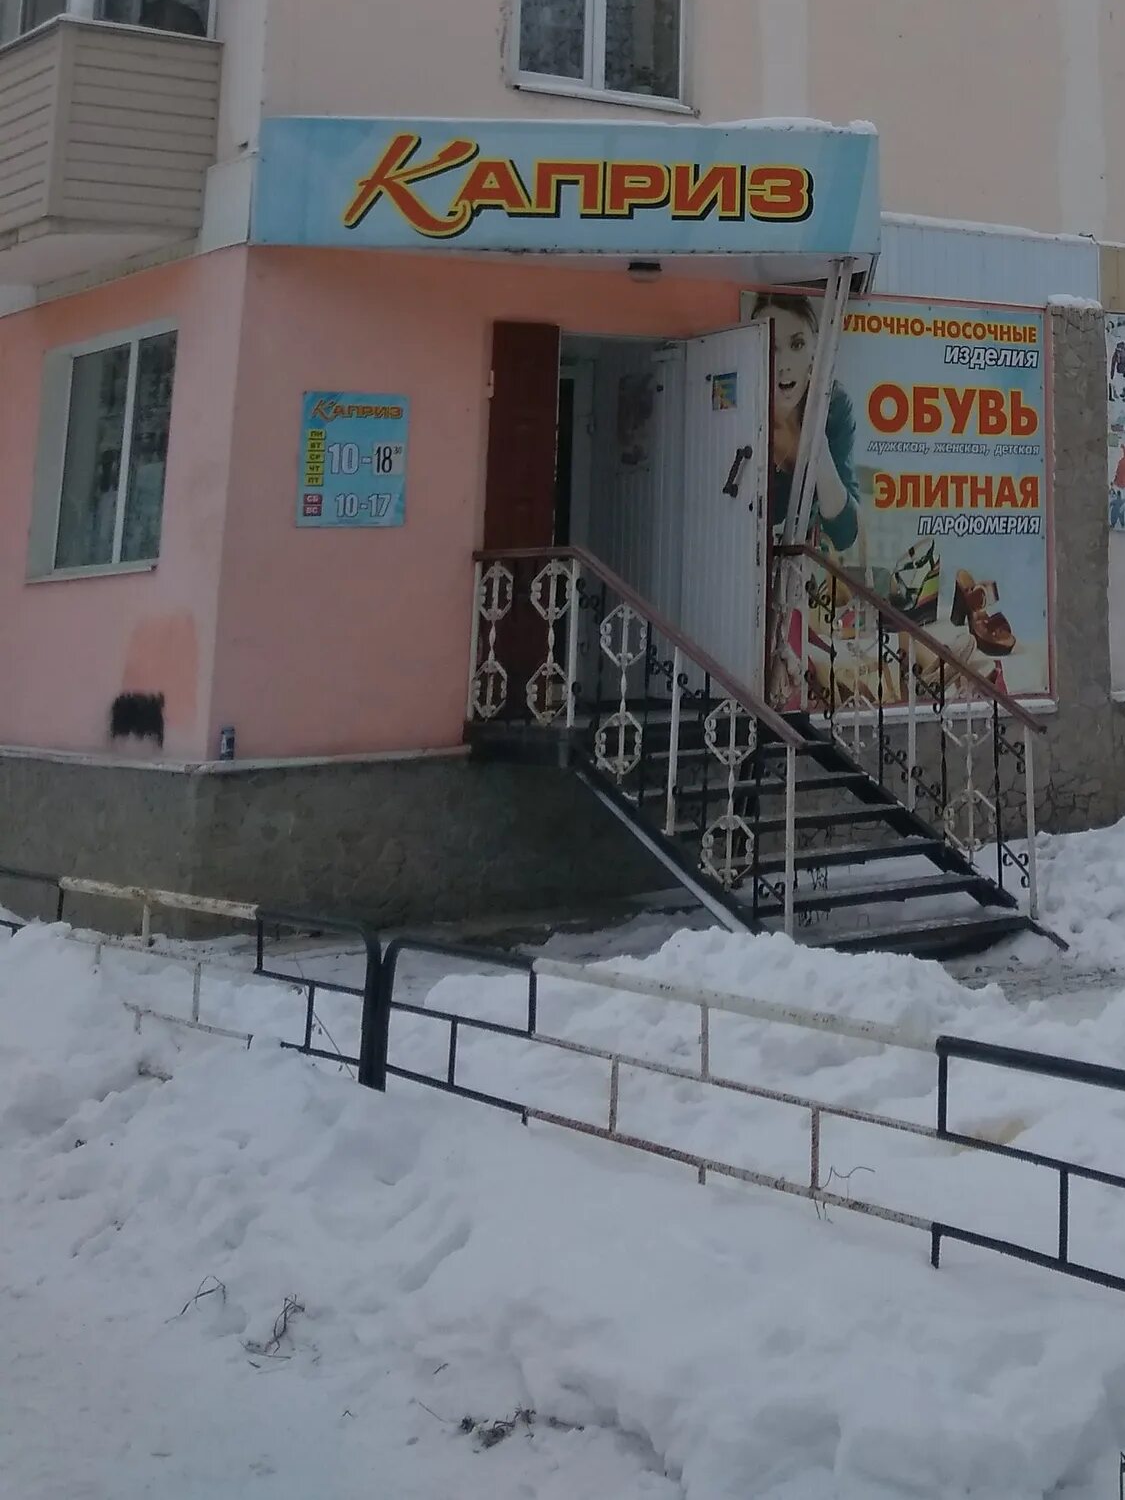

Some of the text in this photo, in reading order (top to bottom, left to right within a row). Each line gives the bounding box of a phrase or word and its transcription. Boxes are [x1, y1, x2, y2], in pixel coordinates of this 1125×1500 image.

[342, 133, 814, 238] КАПРИЗ
[842, 314, 1037, 344] УЛОЧНО-НОСОЧНЫЕ
[944, 345, 1040, 370] изделия
[867, 382, 1040, 437] ОБУВЬ
[867, 440, 1040, 456] мужская, женская, детская
[873, 472, 1040, 509] ЭЛИТНАЯ
[335, 493, 392, 518] 10-17
[917, 514, 1042, 537] ПАРФЮМЕРИЯ
